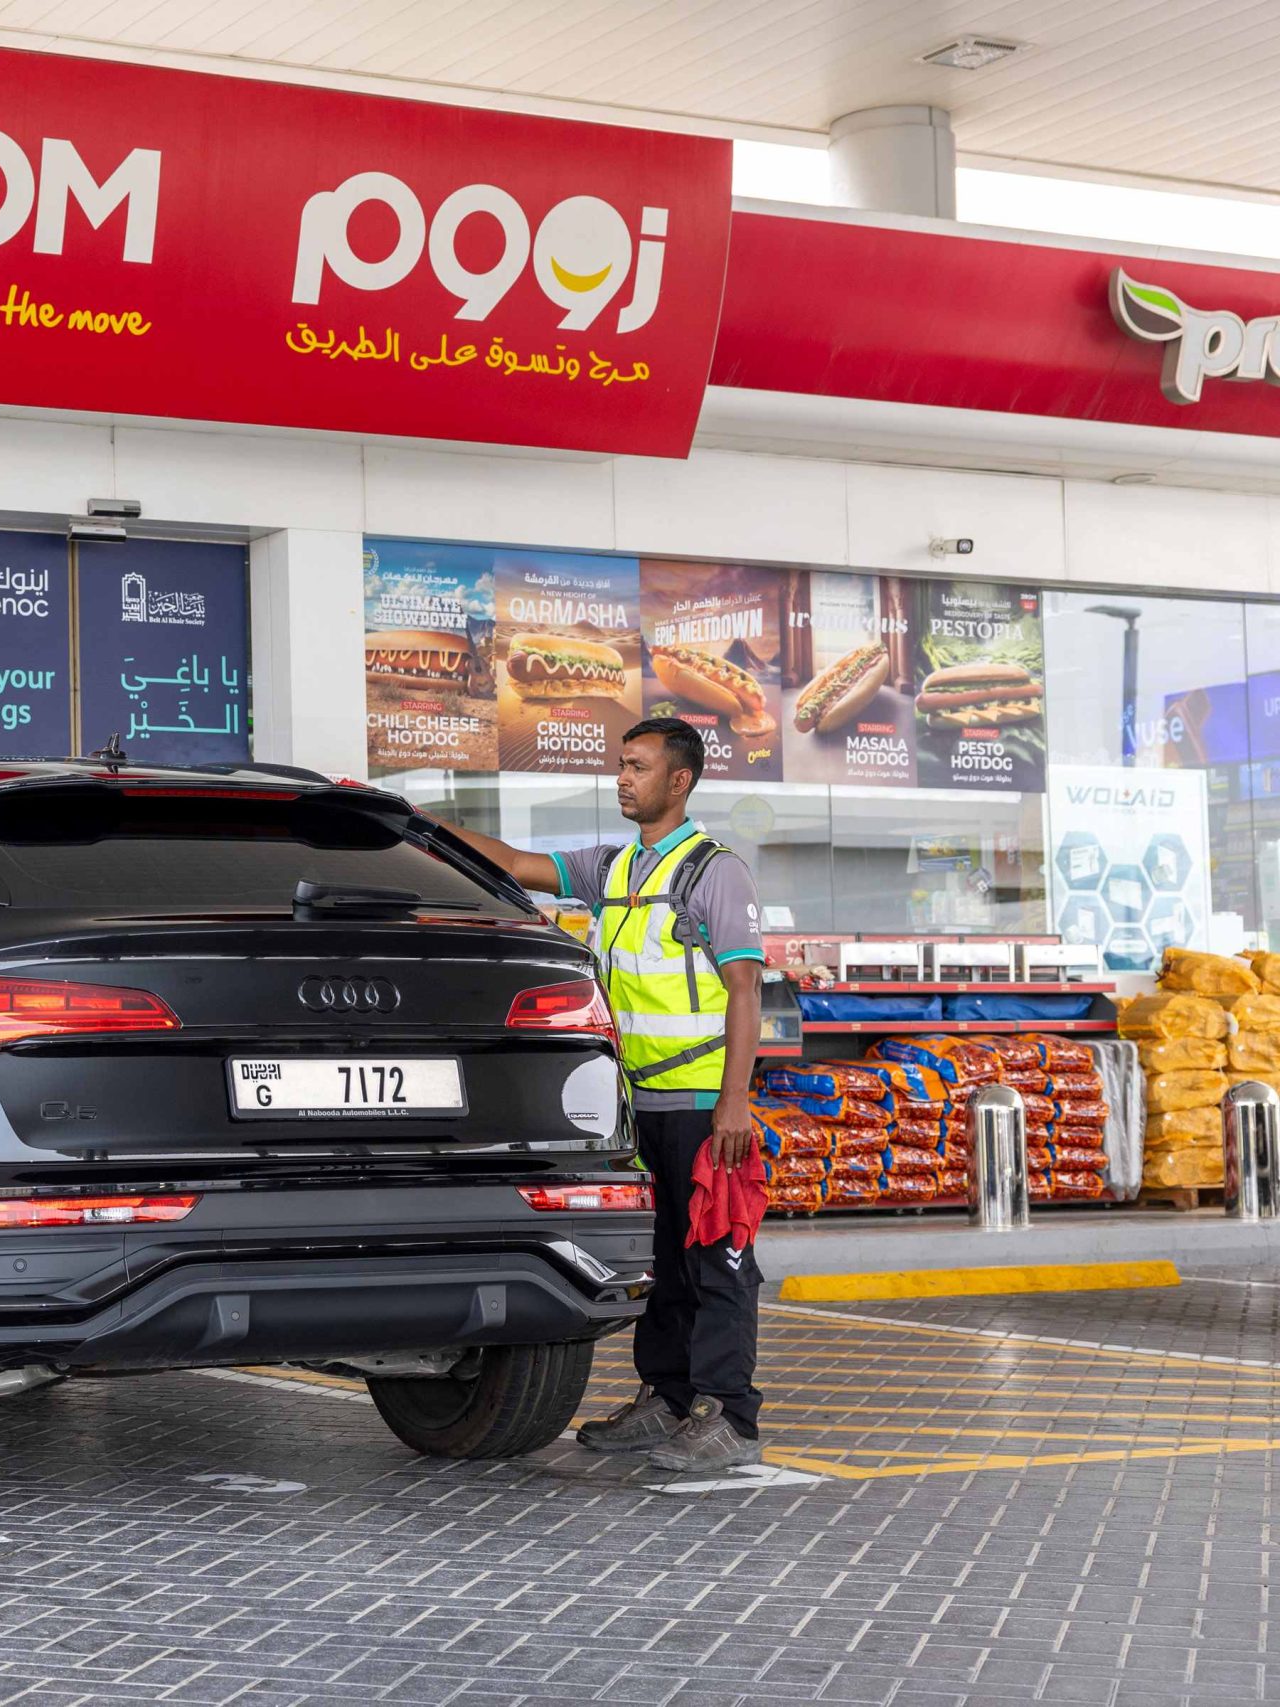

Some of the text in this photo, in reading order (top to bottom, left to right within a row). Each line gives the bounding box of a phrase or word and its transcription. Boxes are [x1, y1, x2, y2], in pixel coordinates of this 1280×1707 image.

[292, 171, 669, 334] زووم
[0, 284, 63, 328] the
[68, 307, 152, 336] move
[286, 322, 650, 385] مرح وتسوق على الطريق
[381, 593, 461, 614] ULTIMATE
[509, 597, 629, 628] QARMASHA
[168, 617, 184, 625] Khair
[374, 609, 468, 628] SHOWDOWN
[655, 608, 763, 646] EPIC MELTDOWN
[930, 618, 1025, 641] PESTOPIA
[221, 655, 238, 694] يا
[403, 701, 442, 711] STARRING
[552, 708, 590, 718] STARRING
[367, 713, 480, 732] CHILI-CHEESE
[537, 721, 605, 738] CRUNCH
[859, 723, 894, 733] STARRING
[387, 730, 460, 746] HOTDOG
[537, 737, 606, 753] HOTDOG
[846, 736, 908, 751] MASALA
[959, 741, 1005, 756] PESTO
[846, 751, 909, 766] HOTDOG
[951, 757, 1013, 771] HOTDOG
[1066, 786, 1176, 807] WOLAID
[338, 1067, 407, 1103] 7172
[256, 1085, 272, 1107] G
[40, 1100, 97, 1121] Q5
